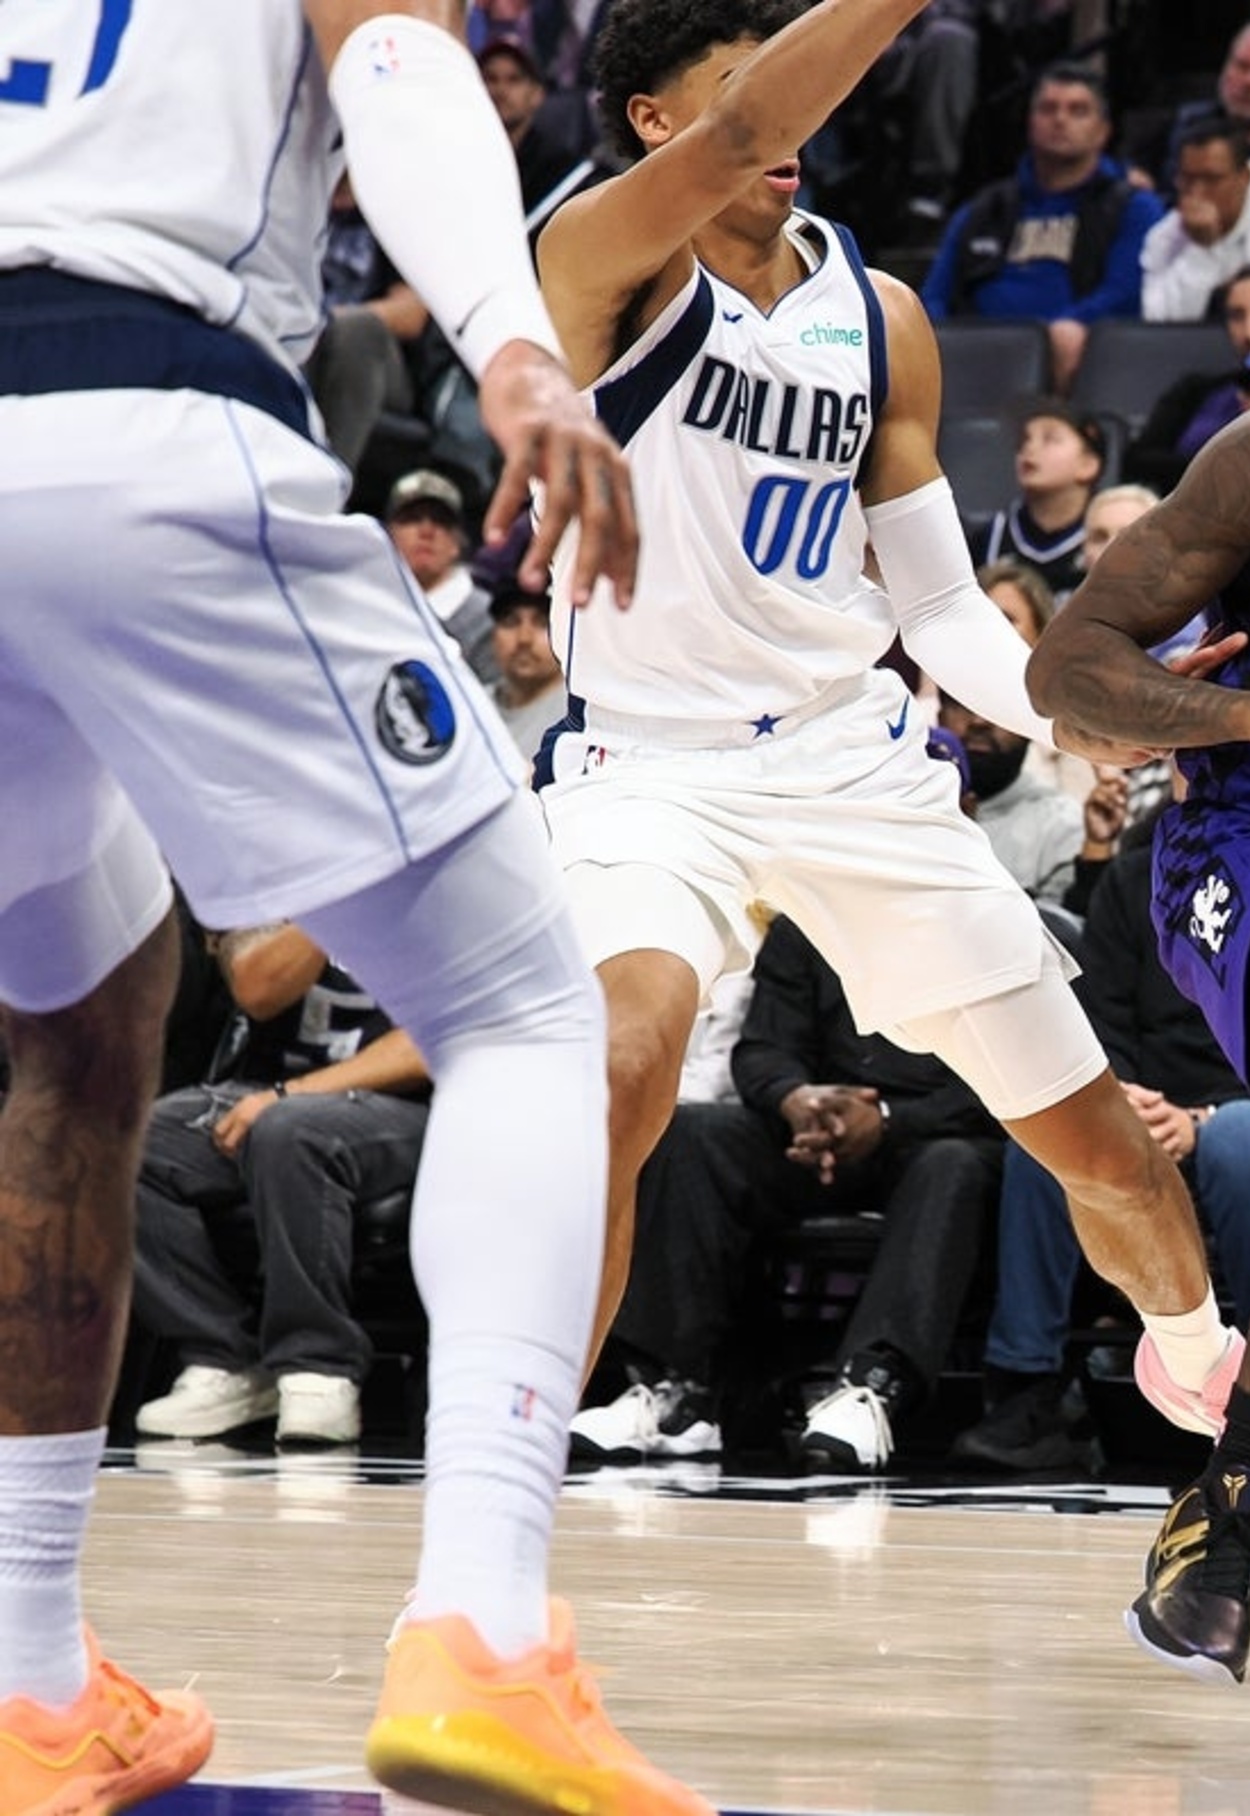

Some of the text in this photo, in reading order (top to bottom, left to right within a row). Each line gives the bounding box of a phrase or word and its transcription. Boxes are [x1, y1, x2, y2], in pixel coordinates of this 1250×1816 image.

[799, 322, 863, 347] chime
[682, 355, 868, 464] DALLAS
[741, 475, 851, 581] 00
